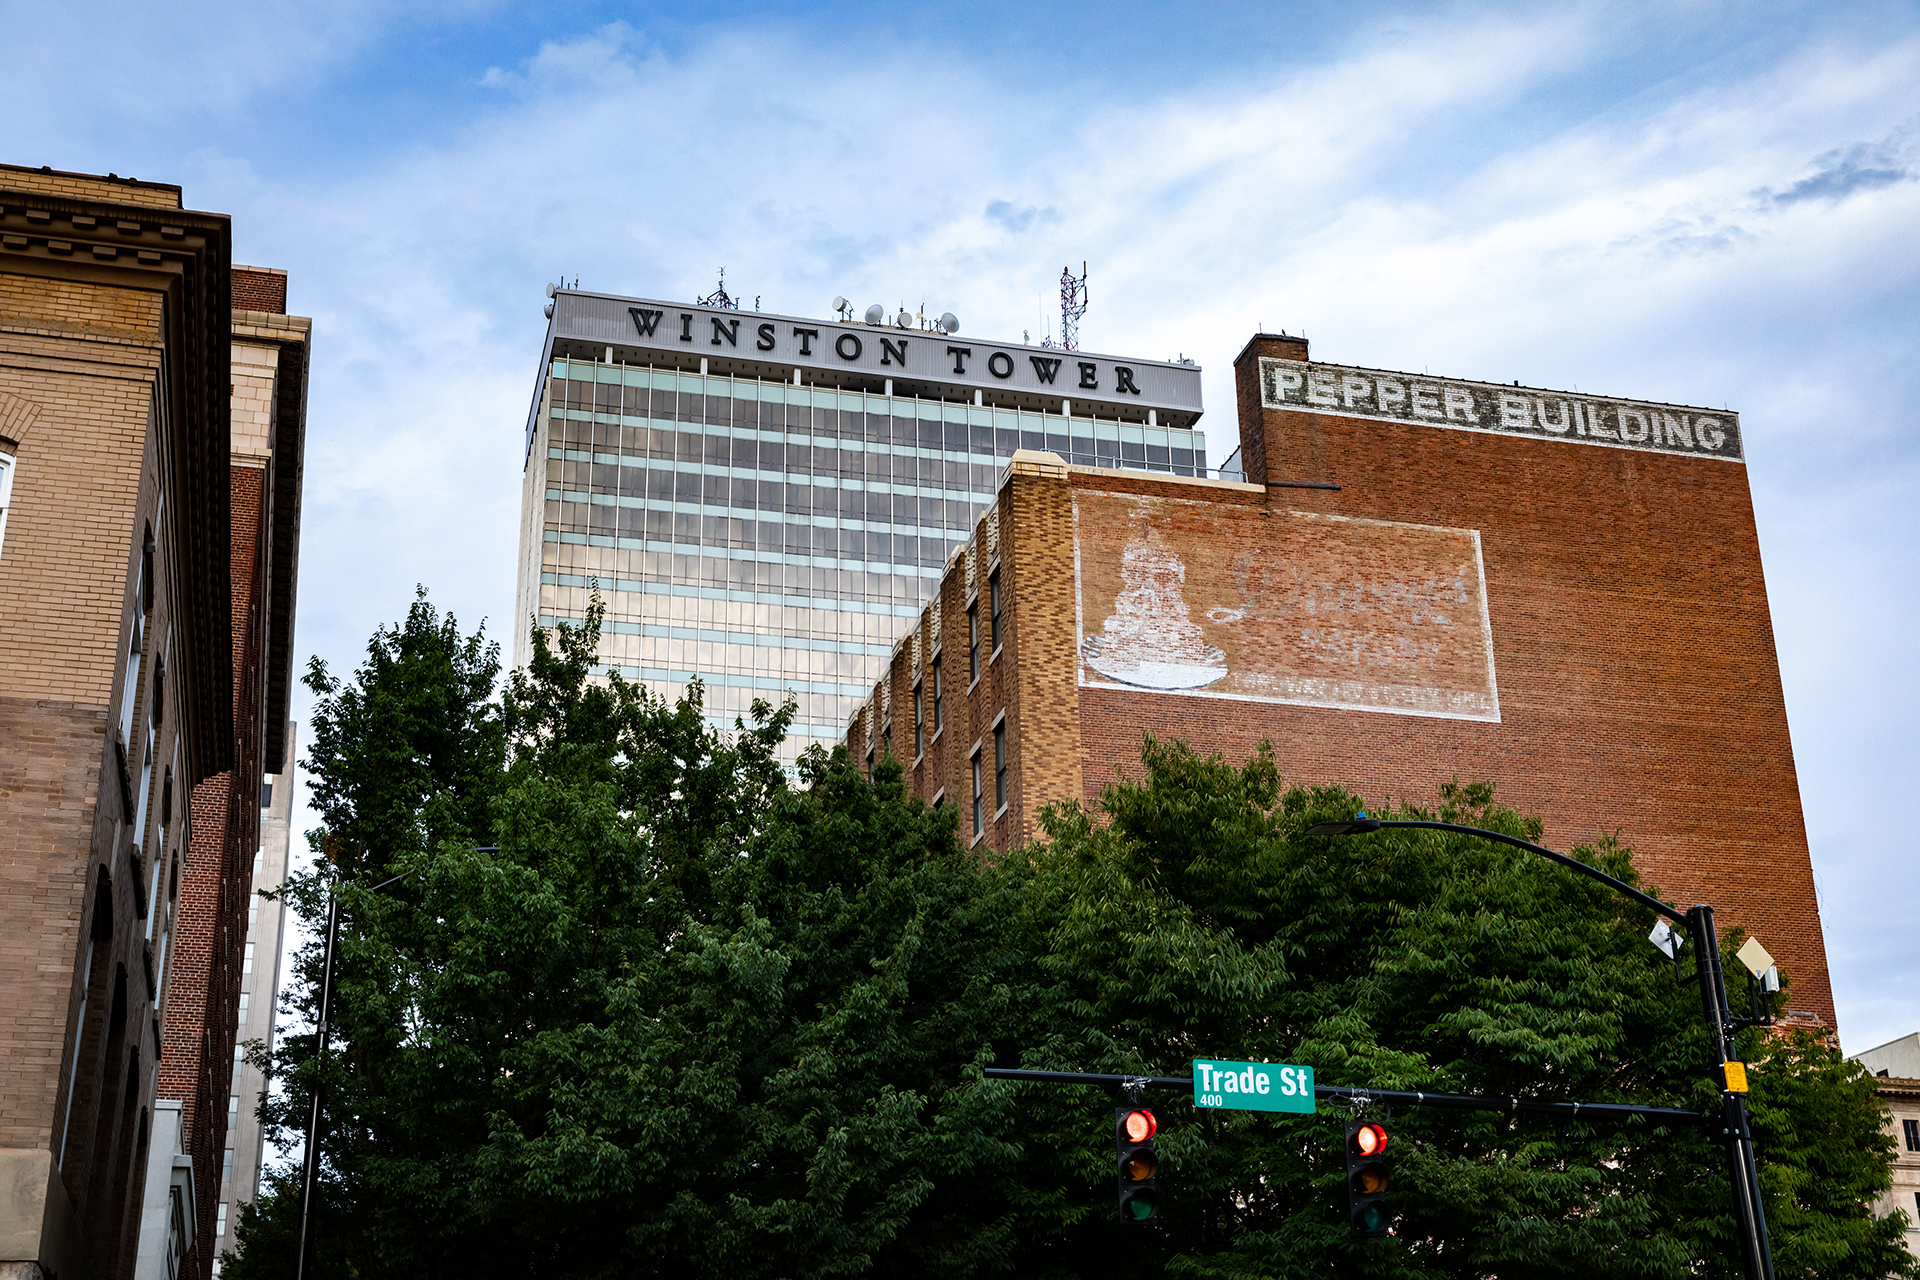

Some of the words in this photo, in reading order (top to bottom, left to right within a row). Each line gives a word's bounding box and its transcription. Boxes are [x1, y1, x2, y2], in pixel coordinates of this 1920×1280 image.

[628, 307, 908, 367] WINSTON
[946, 345, 1141, 395] TOWER
[1274, 367, 1482, 424] PEPPER
[1500, 394, 1726, 450] BUILDING
[1198, 1064, 1270, 1094] Trade
[1281, 1067, 1308, 1096] St
[1200, 1095, 1222, 1106] 400
